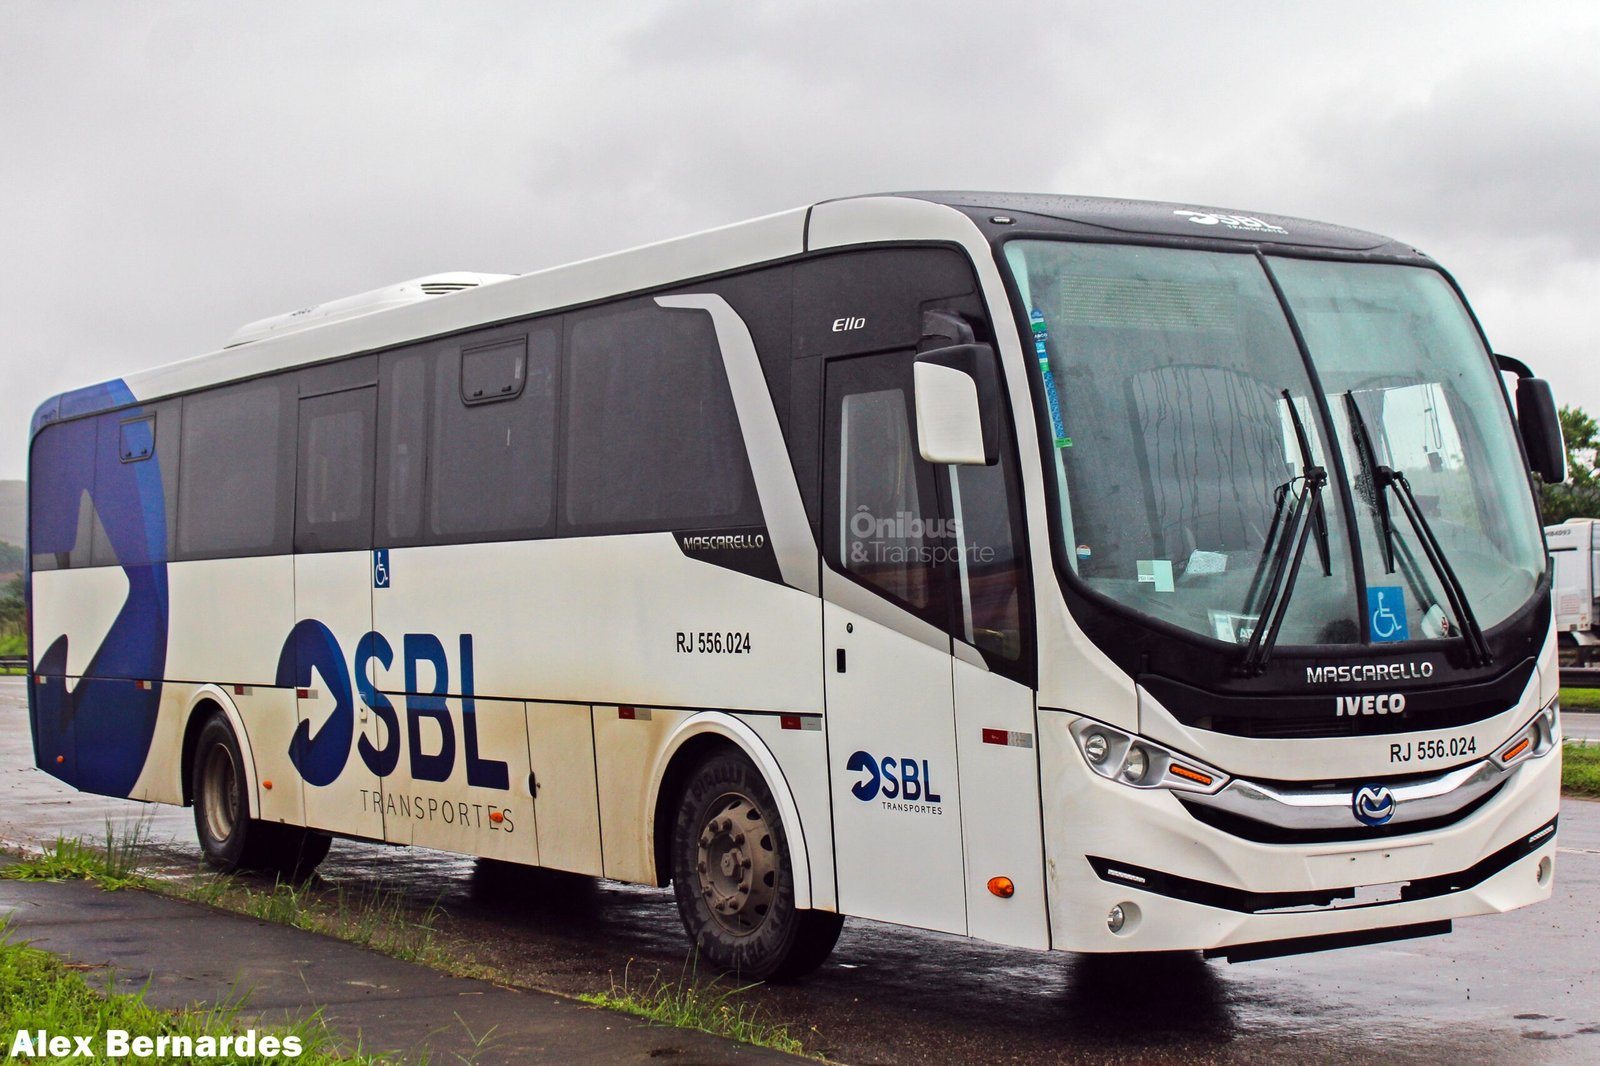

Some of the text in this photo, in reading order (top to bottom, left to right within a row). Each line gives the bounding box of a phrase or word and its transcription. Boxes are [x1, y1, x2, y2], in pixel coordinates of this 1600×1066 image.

[1209, 213, 1284, 230] SBL
[832, 317, 866, 332] Ello
[683, 534, 764, 550] MASCARELLO
[676, 632, 751, 654] RJ 556.024
[1306, 661, 1433, 683] MASCARELLO
[354, 630, 510, 791] SBL
[1336, 693, 1406, 716] IVECO
[1390, 735, 1477, 763] RJ 556.024
[881, 756, 941, 803] SBL
[360, 789, 515, 833] TRANSPORTES
[882, 801, 943, 815] TRANSPORTES
